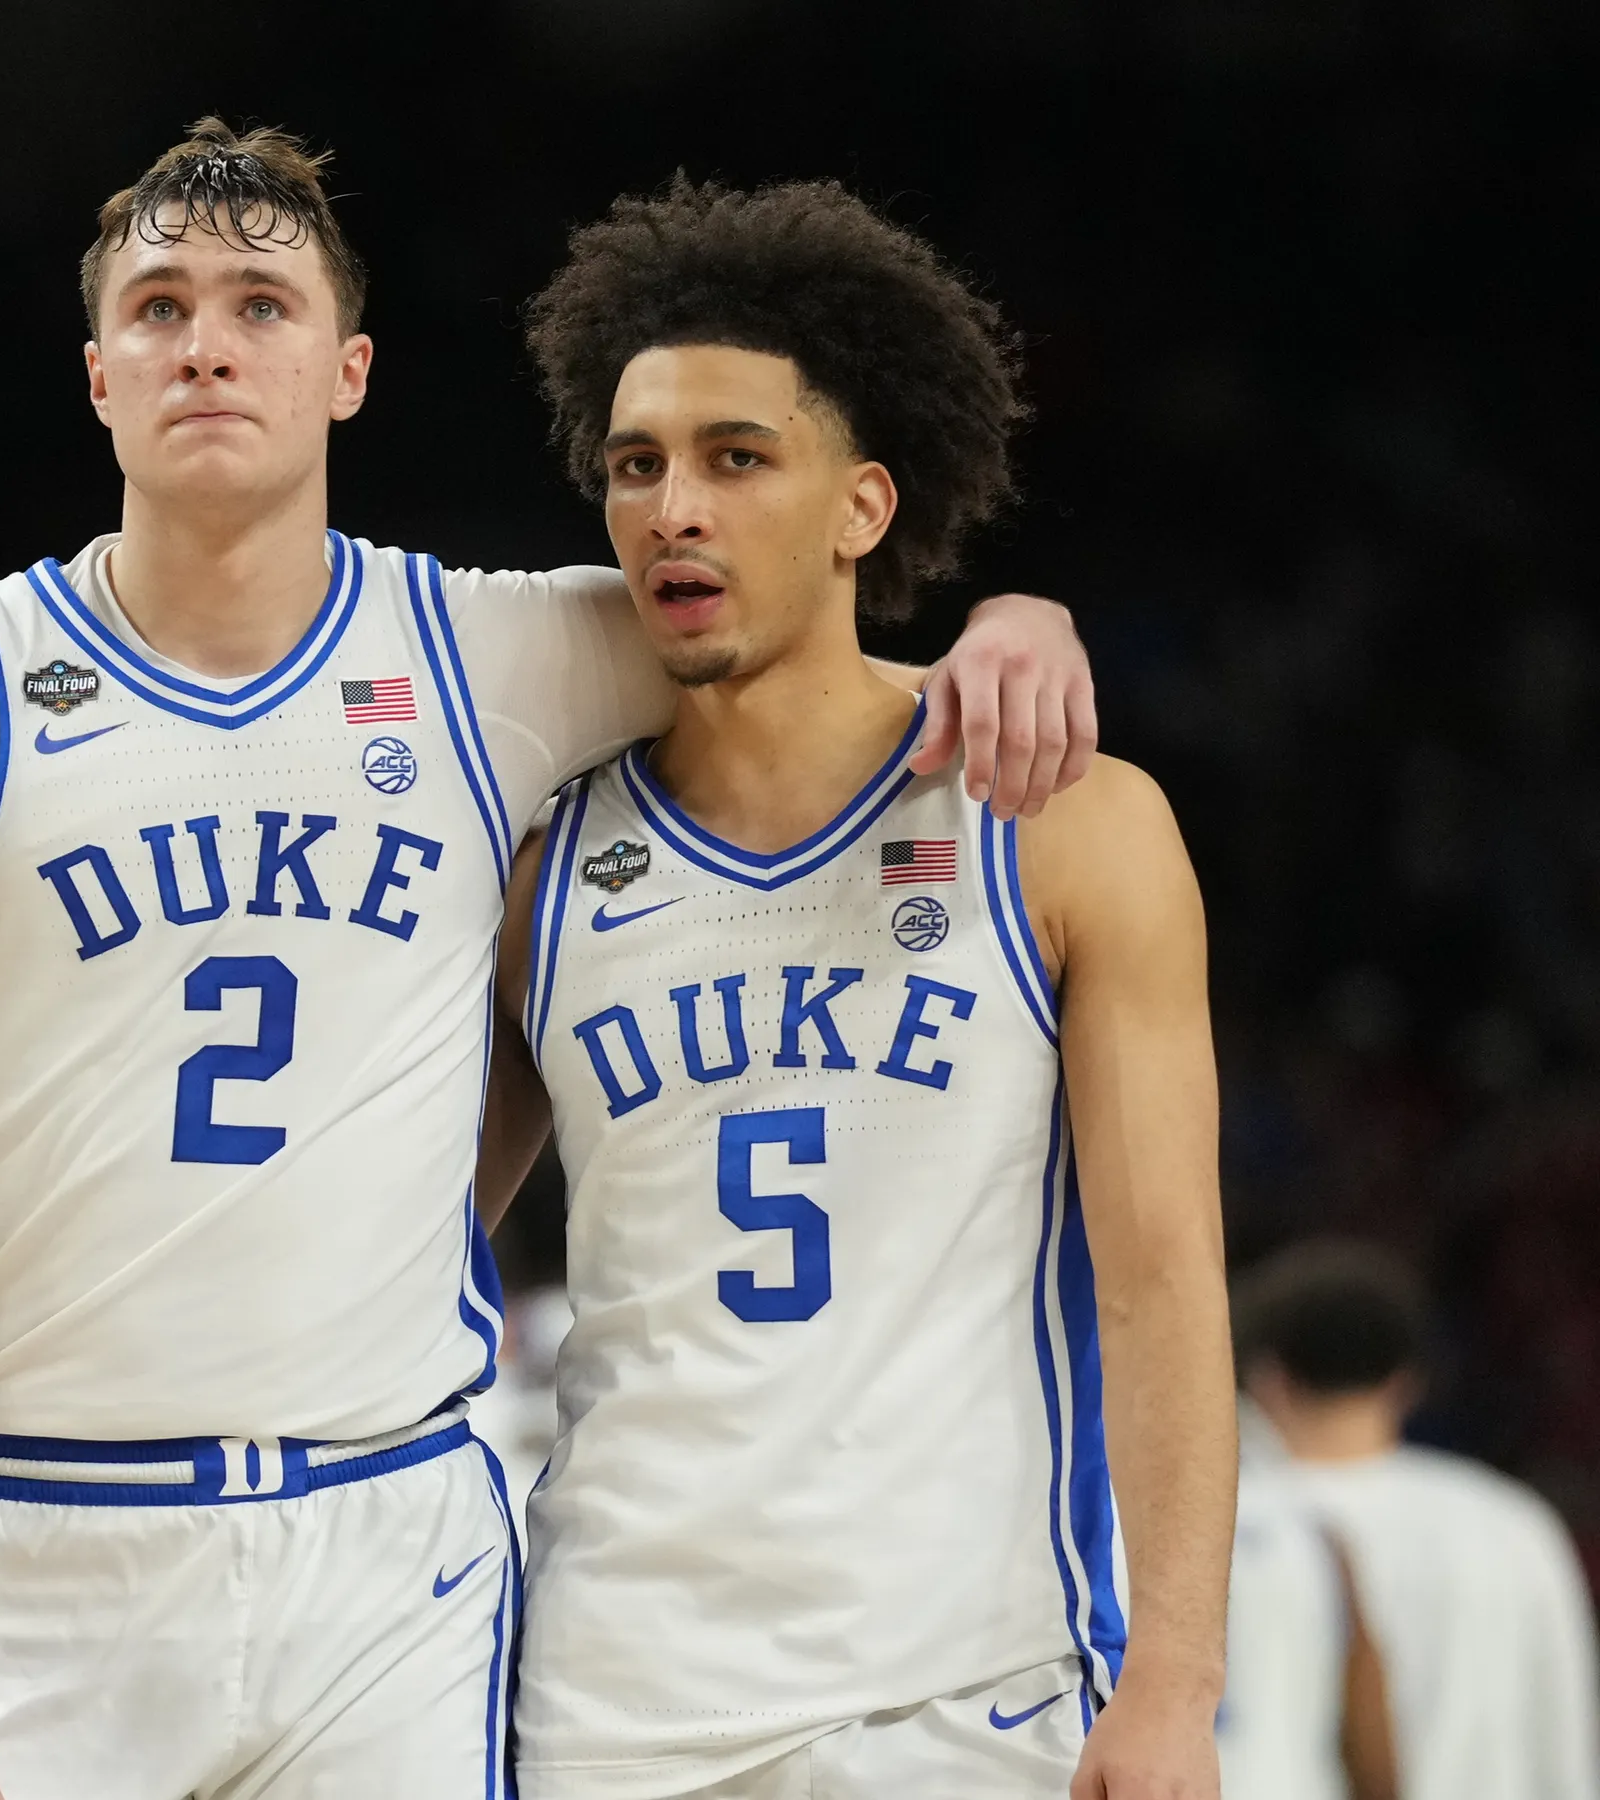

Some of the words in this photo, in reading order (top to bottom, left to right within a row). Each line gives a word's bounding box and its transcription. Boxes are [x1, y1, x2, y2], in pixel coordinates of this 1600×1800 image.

[27, 680, 61, 693] FINAL
[63, 676, 96, 691] FOUR
[368, 755, 413, 770] ACC
[37, 811, 443, 960] DUKE
[587, 860, 619, 875] FINAL
[620, 852, 649, 870] FOUR
[898, 912, 946, 929] ACC
[171, 955, 298, 1166] 2
[572, 966, 977, 1118] DUKE
[716, 1105, 832, 1324] 5
[218, 1437, 284, 1496] D
